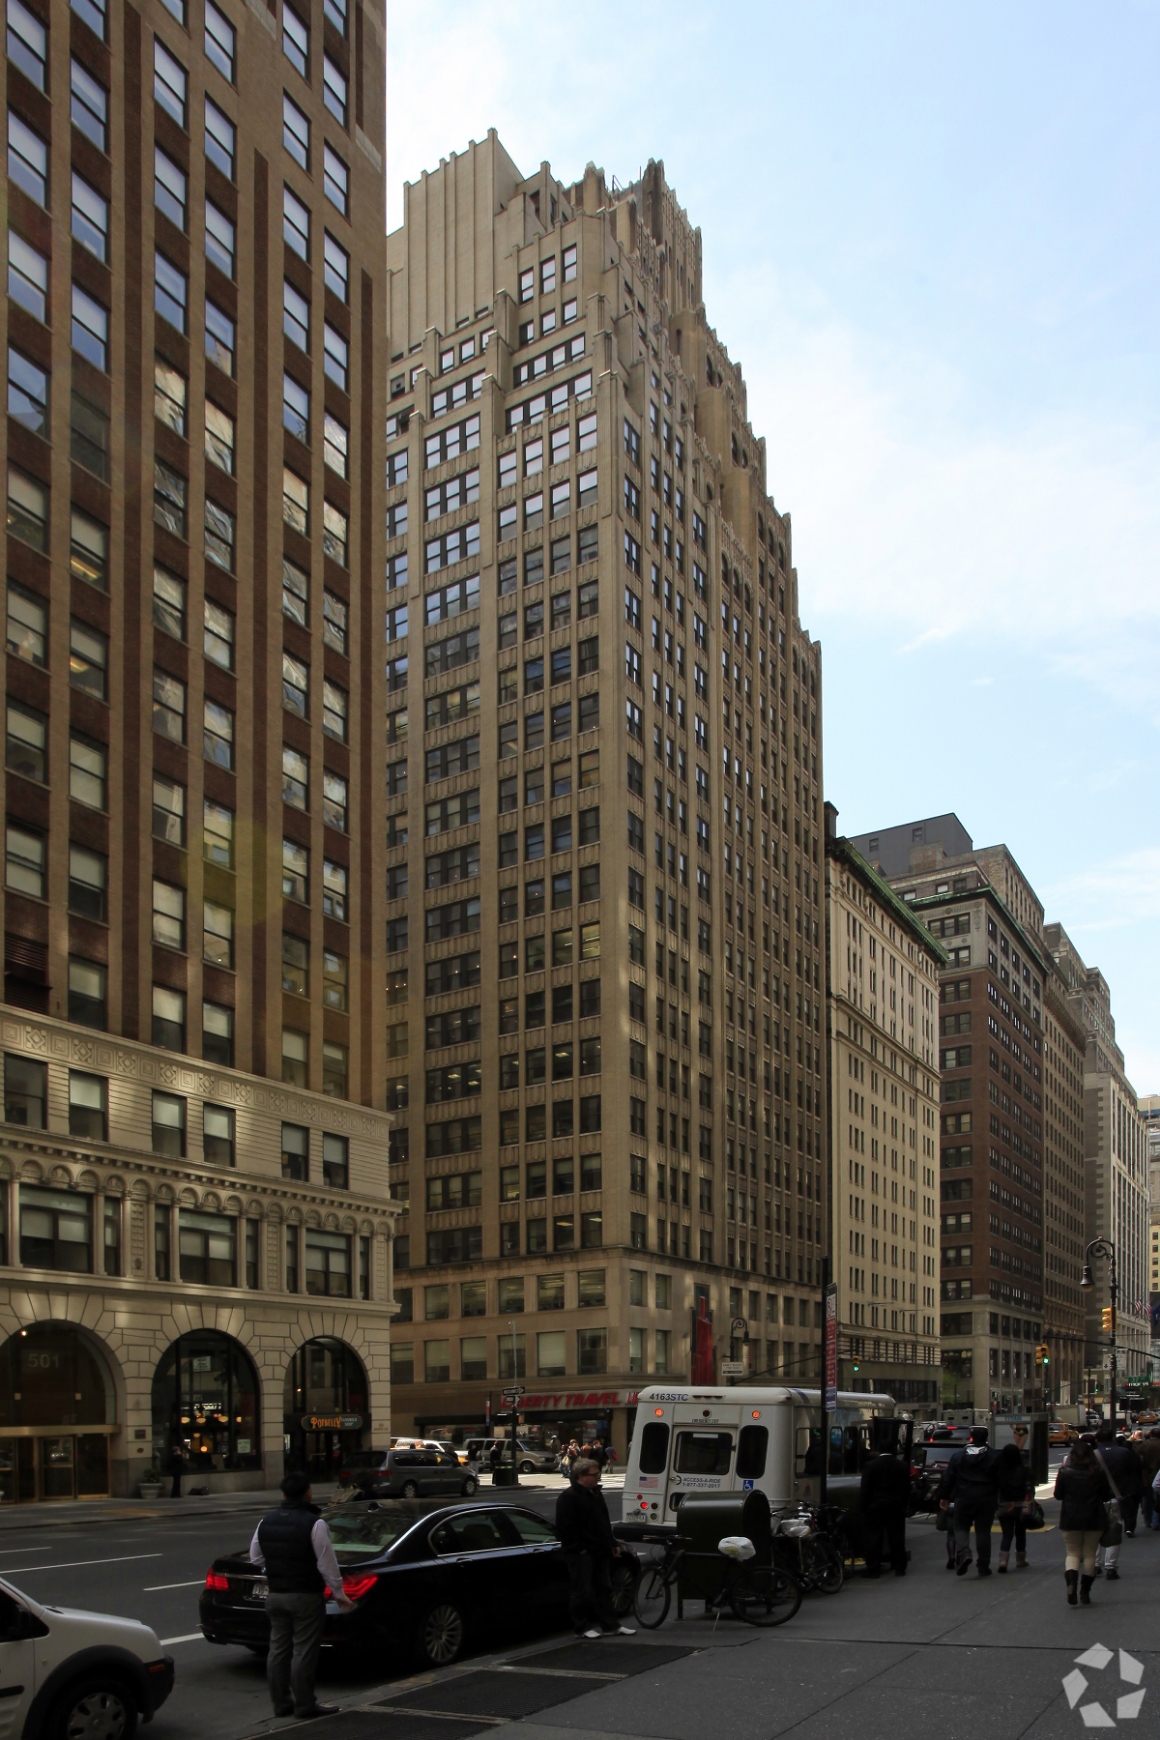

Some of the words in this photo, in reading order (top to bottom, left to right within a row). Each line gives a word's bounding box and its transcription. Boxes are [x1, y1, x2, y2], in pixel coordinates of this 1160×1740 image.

[28, 1353, 59, 1369] 501
[564, 1392, 620, 1407] TRAVEL
[649, 1393, 689, 1402] 4163STC
[310, 1416, 342, 1429] POTBELLY
